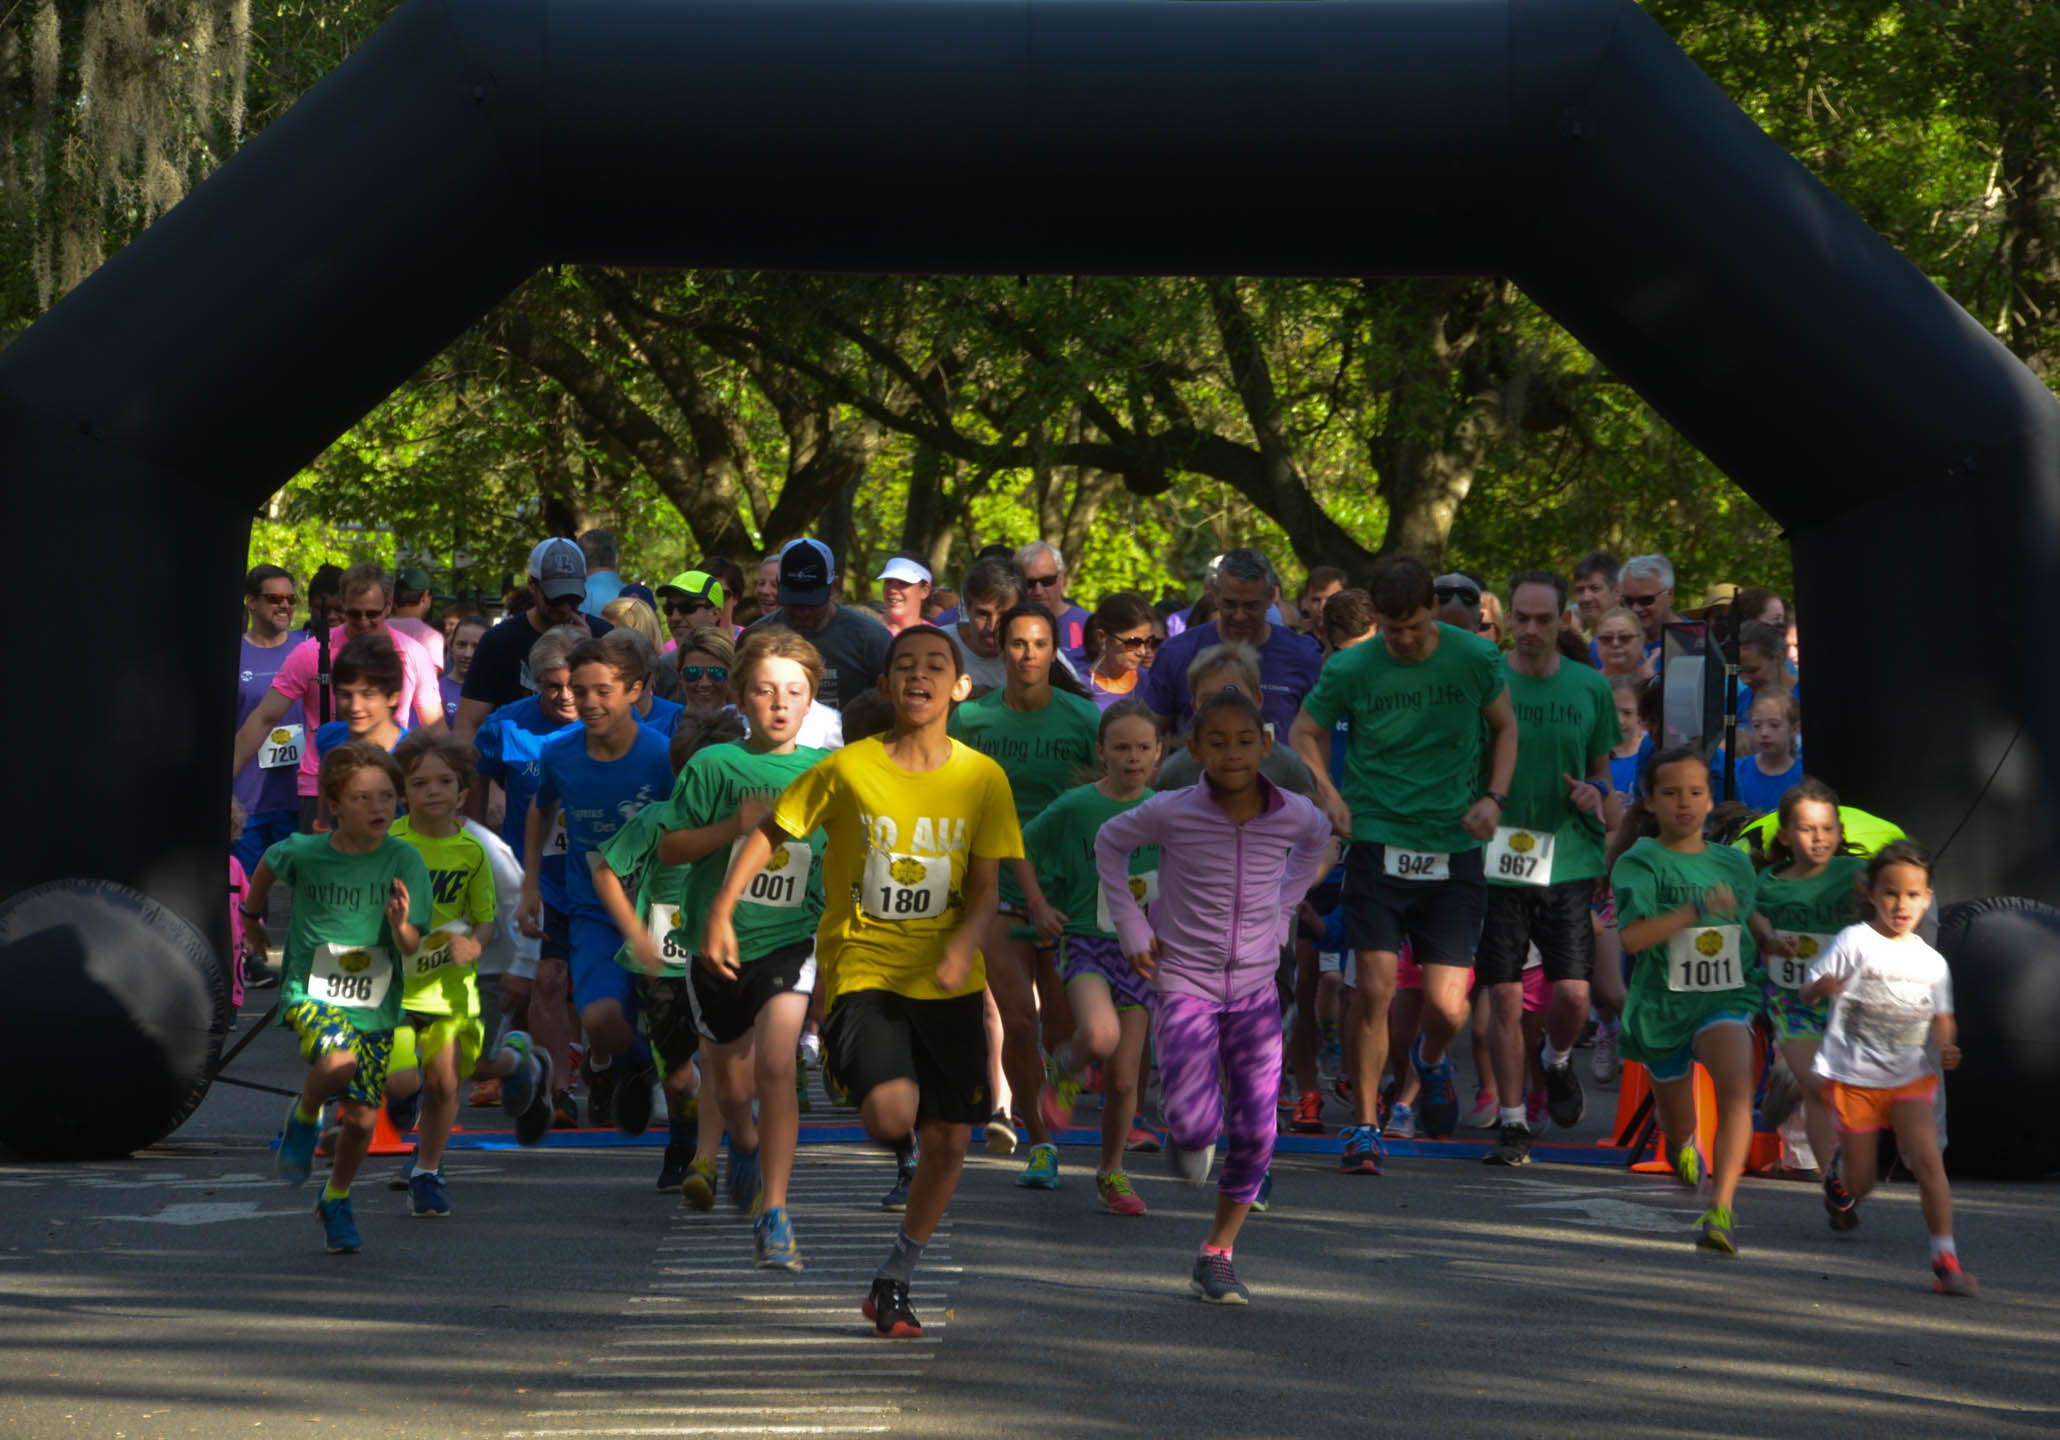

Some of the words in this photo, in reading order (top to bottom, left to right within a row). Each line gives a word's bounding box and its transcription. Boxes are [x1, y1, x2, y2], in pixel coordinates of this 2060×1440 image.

[1368, 690, 1422, 714] Loving
[1428, 684, 1464, 705] Life
[1549, 701, 1582, 727] Life
[268, 745, 298, 763] 720
[1398, 853, 1435, 875] 942
[1499, 852, 1538, 878] 967
[742, 872, 796, 902] 001
[880, 886, 931, 914] 180
[1681, 957, 1731, 986] 1011
[326, 973, 373, 1001] 986
